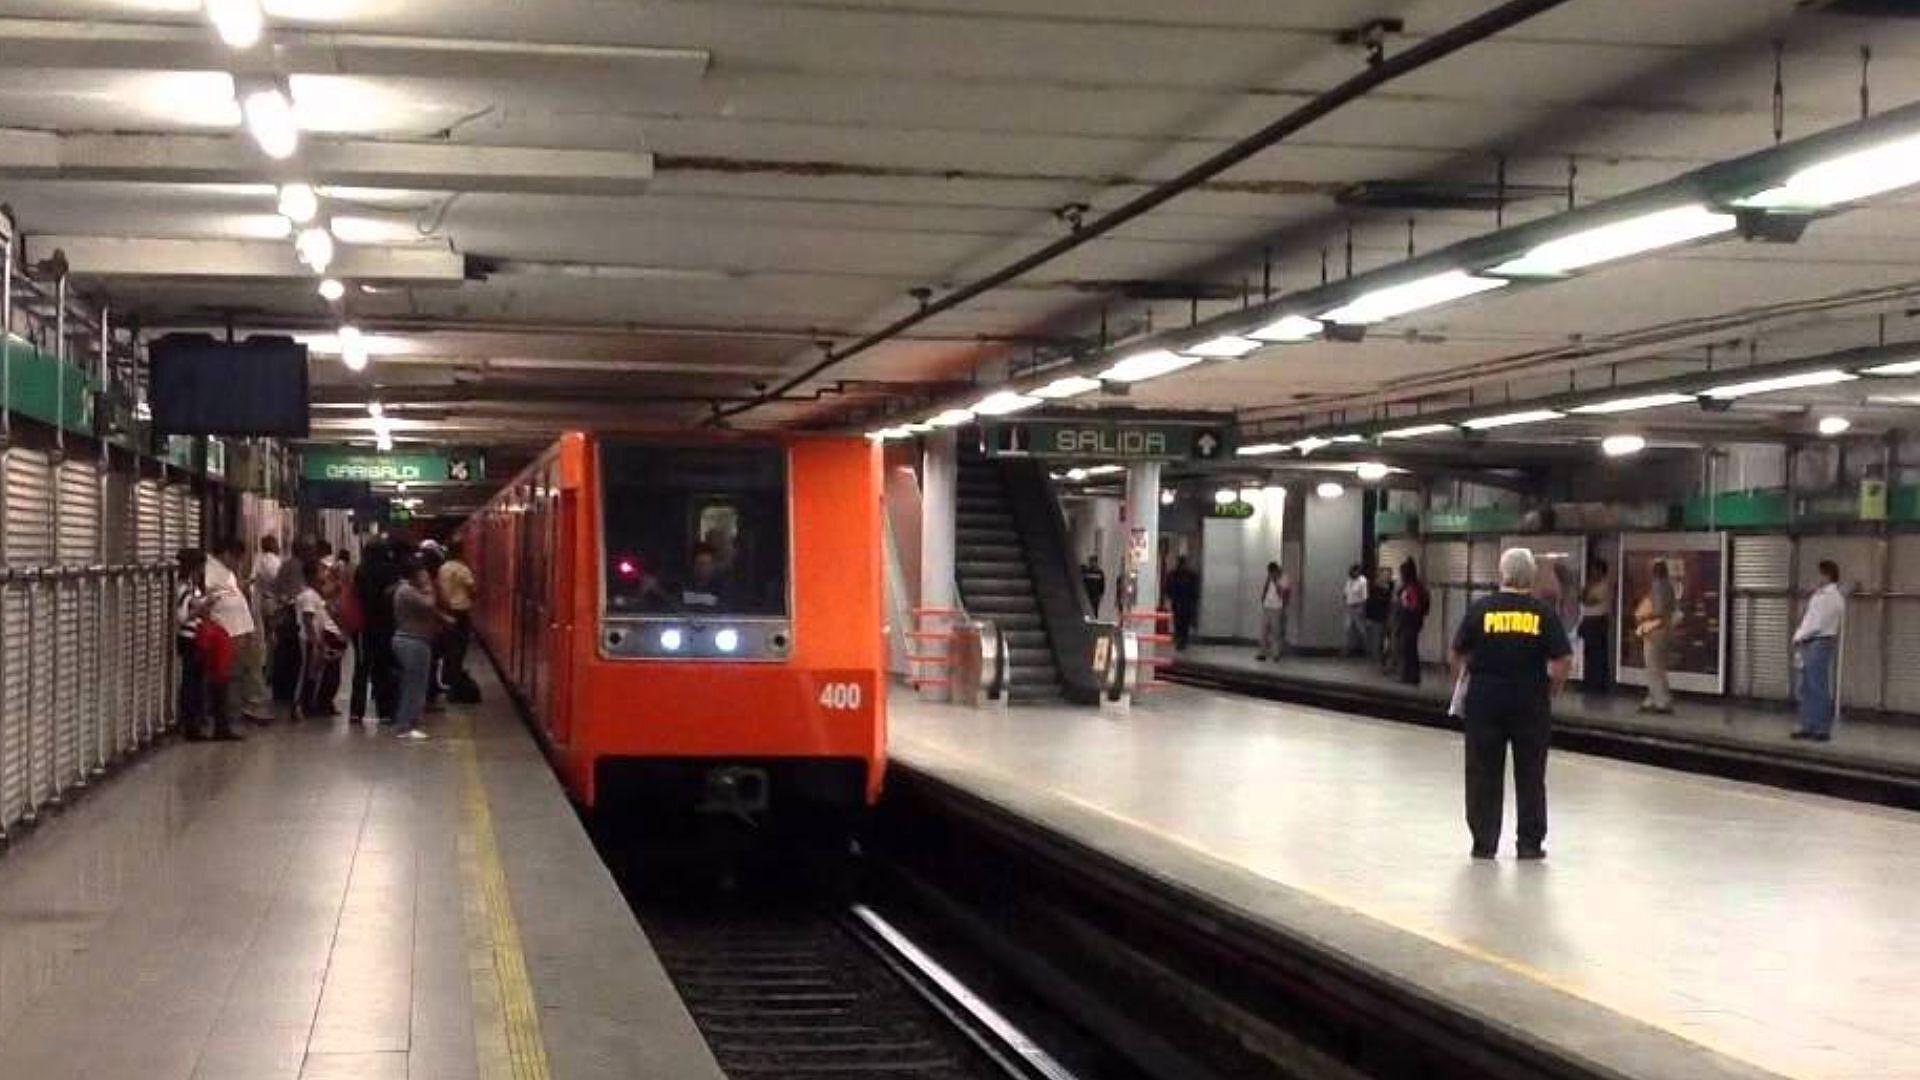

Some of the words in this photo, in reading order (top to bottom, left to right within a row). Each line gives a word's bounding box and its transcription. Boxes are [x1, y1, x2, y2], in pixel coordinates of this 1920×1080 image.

[1056, 430, 1166, 454] SALIDA
[326, 463, 420, 480] GARIBALDI
[1483, 611, 1541, 635] PATROL
[819, 682, 861, 709] 400
